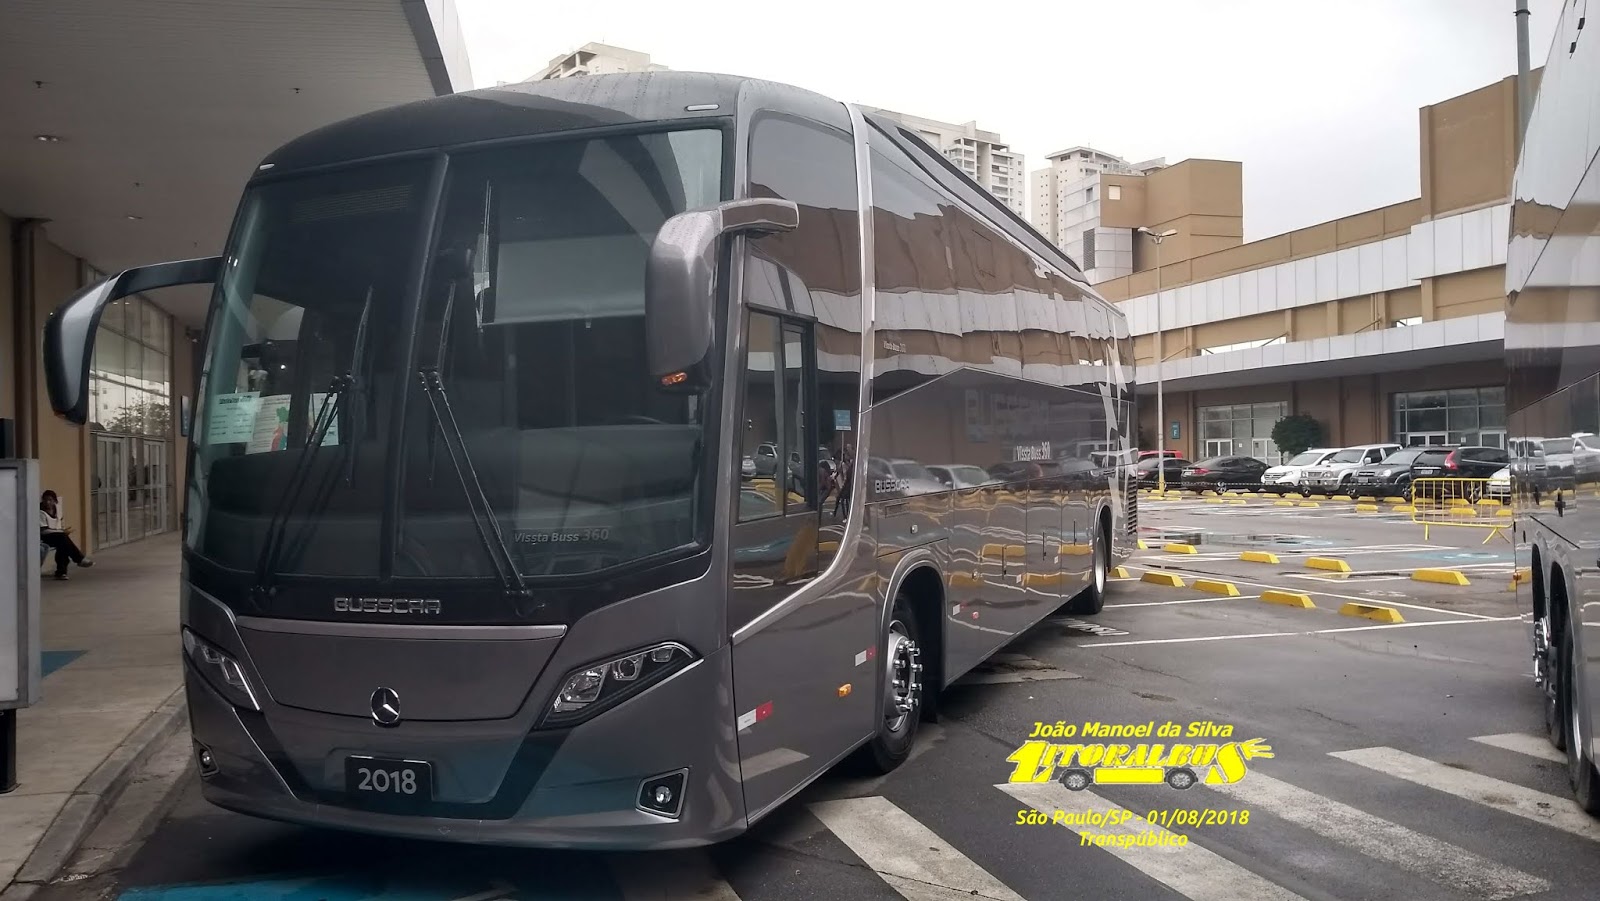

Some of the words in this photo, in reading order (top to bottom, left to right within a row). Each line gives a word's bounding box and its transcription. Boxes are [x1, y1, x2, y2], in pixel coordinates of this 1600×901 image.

[875, 479, 910, 493] BUSSCAR
[514, 532, 549, 543] Vissta
[550, 532, 580, 542] Buss
[581, 528, 610, 541] 360
[334, 597, 441, 614] BUSSCAR
[358, 767, 417, 795] 2018
